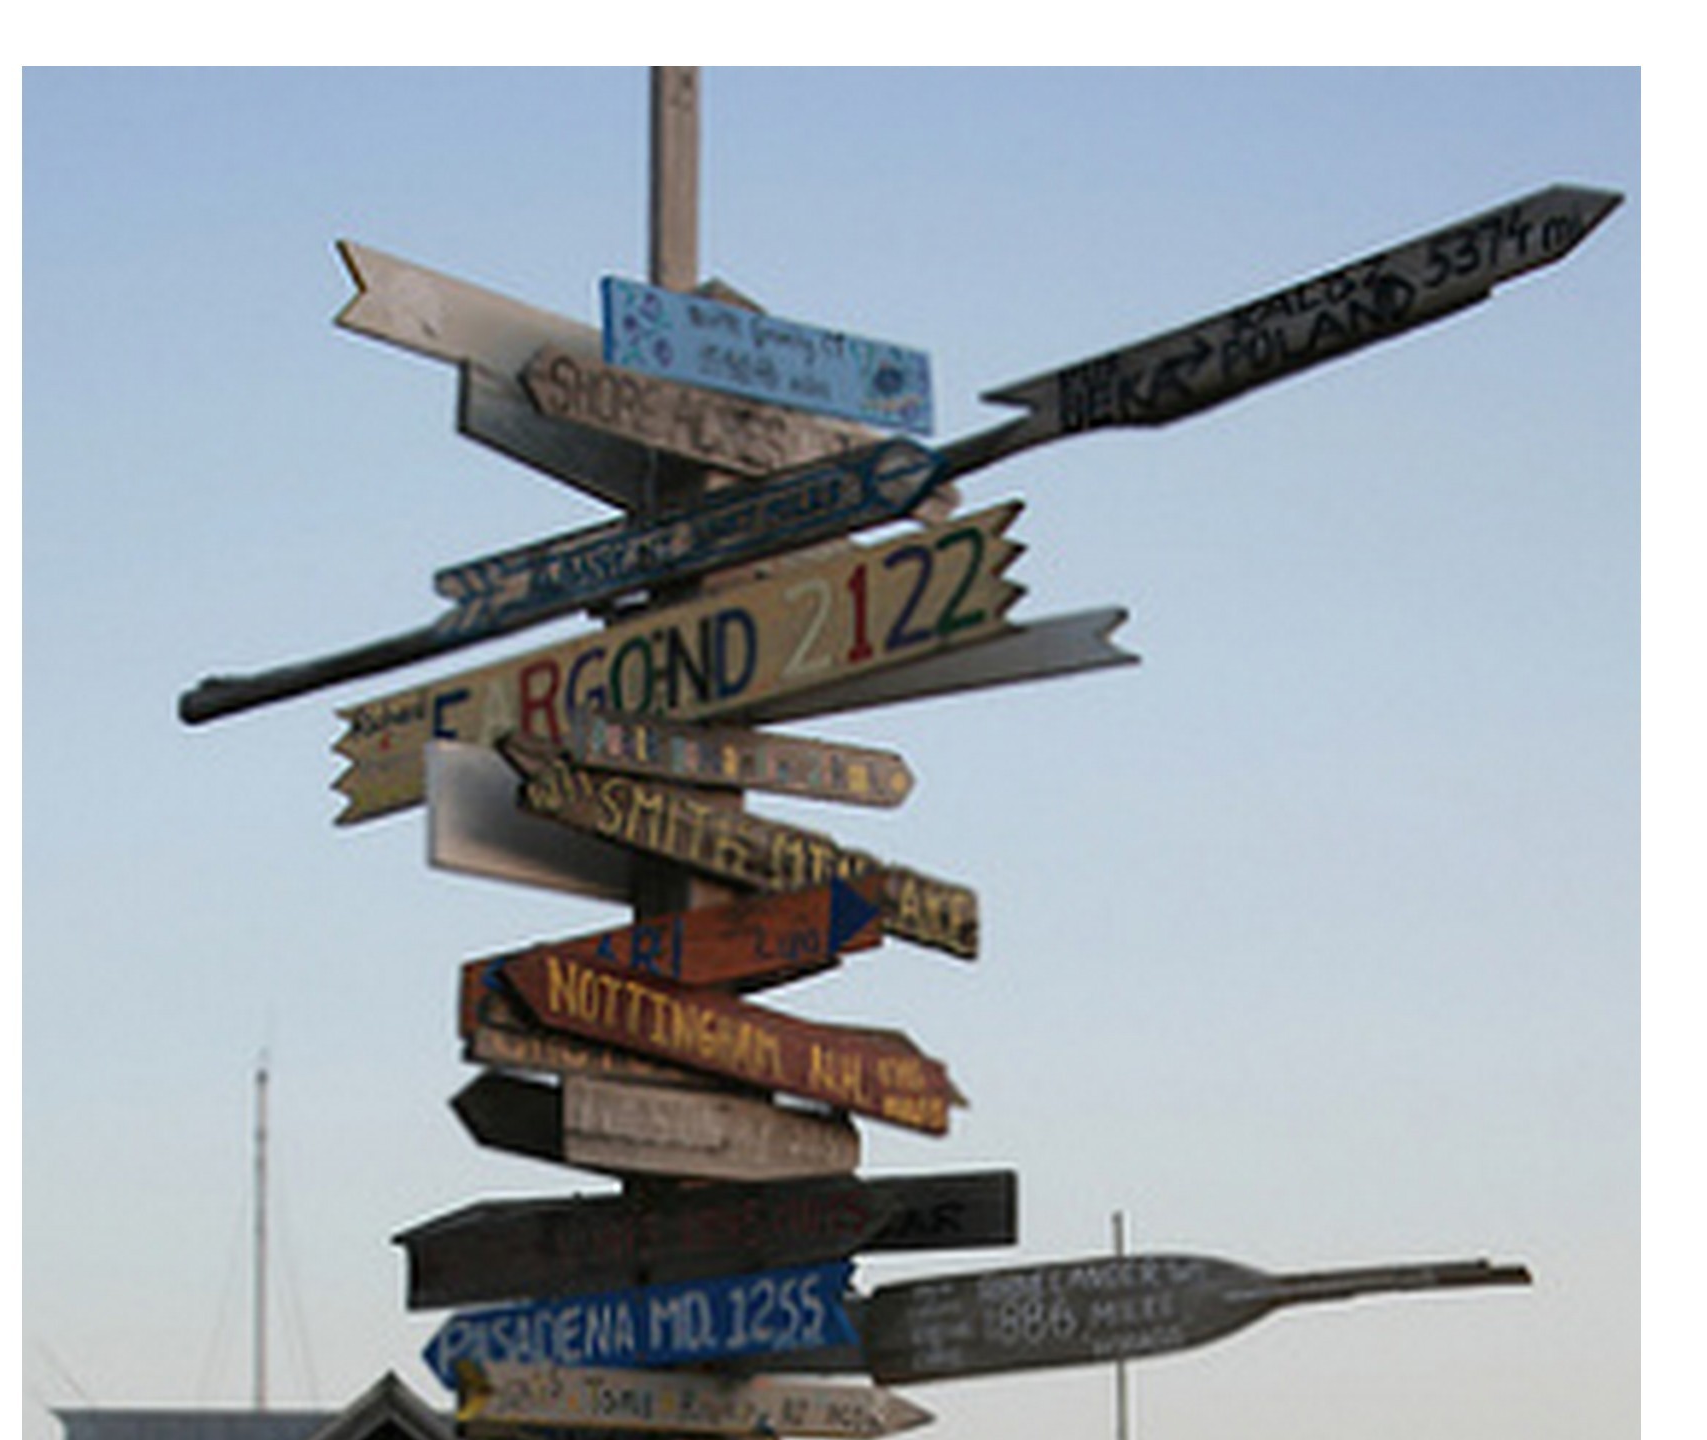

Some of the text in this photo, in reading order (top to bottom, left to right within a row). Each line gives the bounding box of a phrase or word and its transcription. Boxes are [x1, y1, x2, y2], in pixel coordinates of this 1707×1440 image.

[1423, 207, 1533, 289] 5374
[1220, 271, 1415, 377] POLAND
[785, 527, 983, 674] 2122
[546, 955, 783, 1082] NOTTINGHAM
[725, 1274, 826, 1347] 1255
